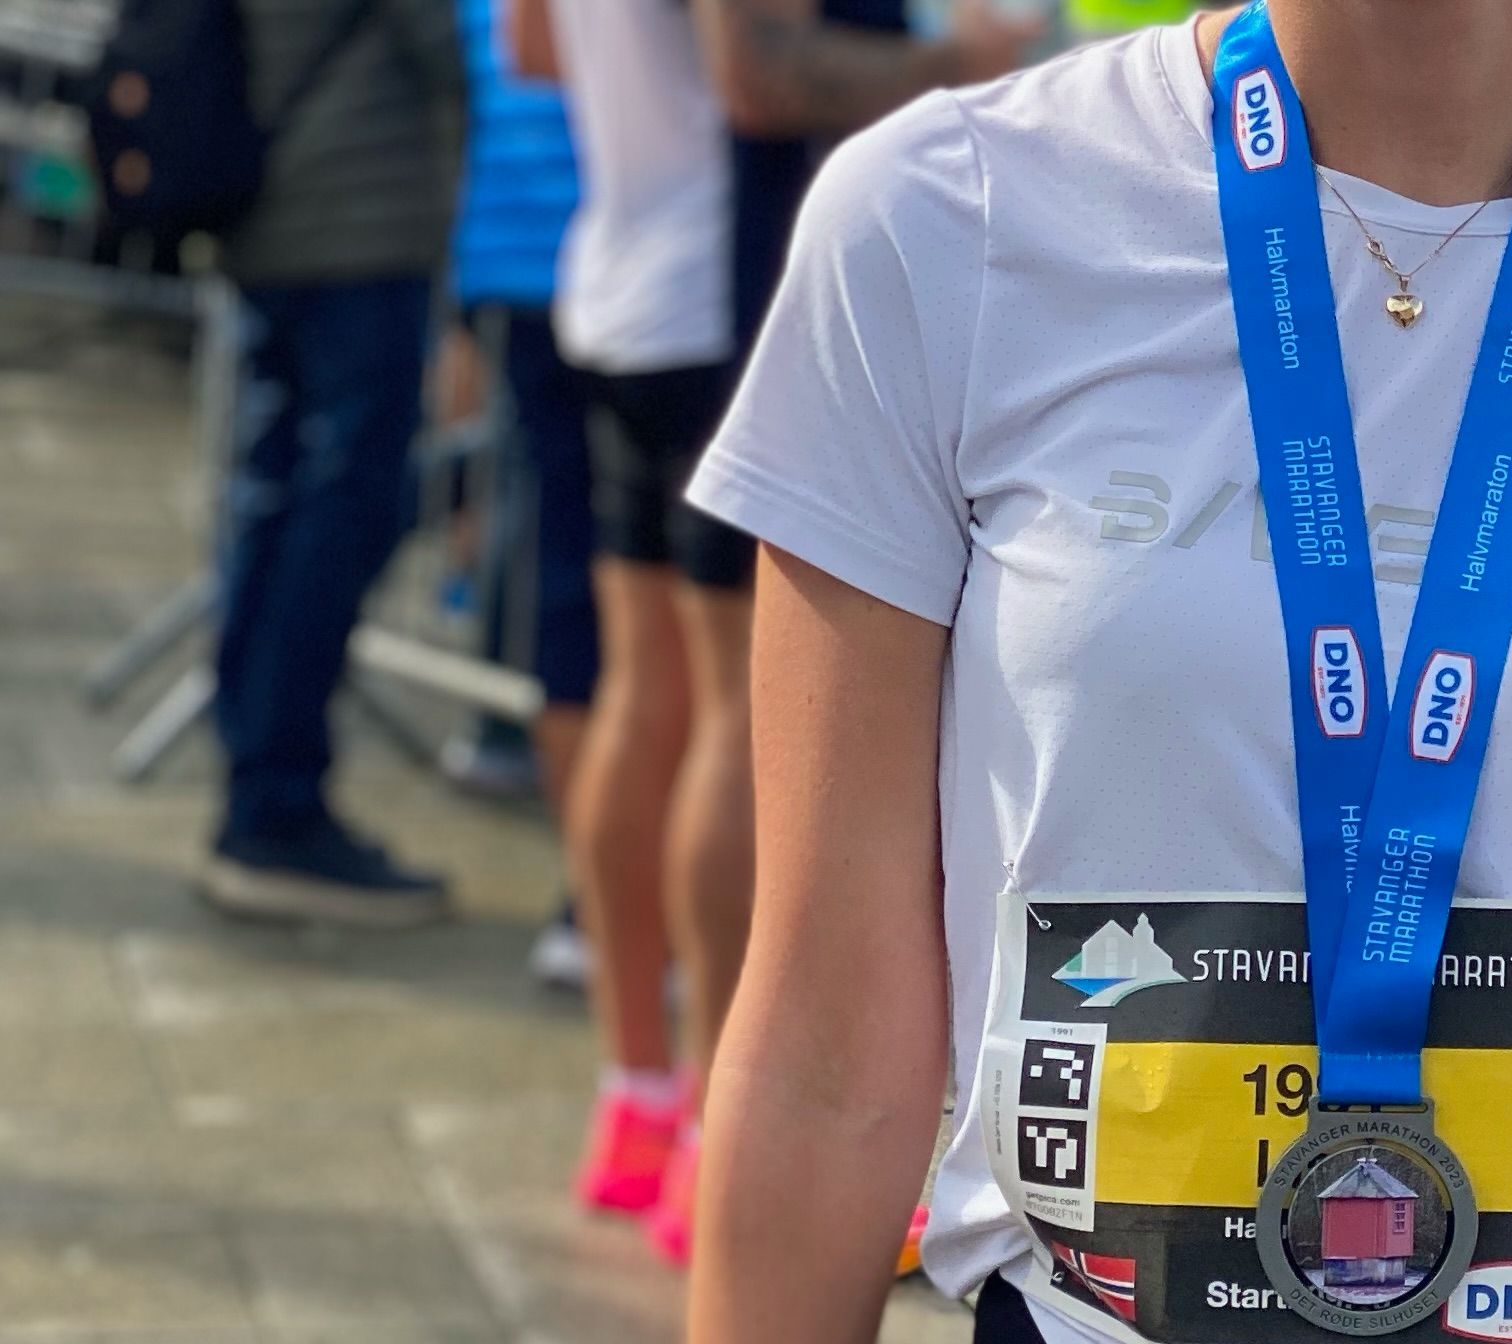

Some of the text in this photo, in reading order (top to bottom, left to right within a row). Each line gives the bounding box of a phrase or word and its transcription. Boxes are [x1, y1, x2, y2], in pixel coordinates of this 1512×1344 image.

[1244, 83, 1275, 156] DNO
[1264, 227, 1300, 370] Halvmaraton
[1282, 440, 1321, 566] MARATHON
[1308, 435, 1348, 567] STAVANGER
[1460, 454, 1512, 593] Halvmaraton
[1323, 642, 1355, 724] DNO
[1422, 667, 1462, 748] DNO
[1363, 828, 1411, 962] STAVANGER
[1389, 834, 1437, 964] MARATHON
[1275, 1124, 1350, 1187] STAVANGER
[1357, 1121, 1443, 1157] MARATHON
[1439, 1155, 1464, 1189] 2023
[1290, 1289, 1316, 1313] DET
[1320, 1309, 1362, 1329] RØDE
[1369, 1289, 1438, 1329] SILHUSET
